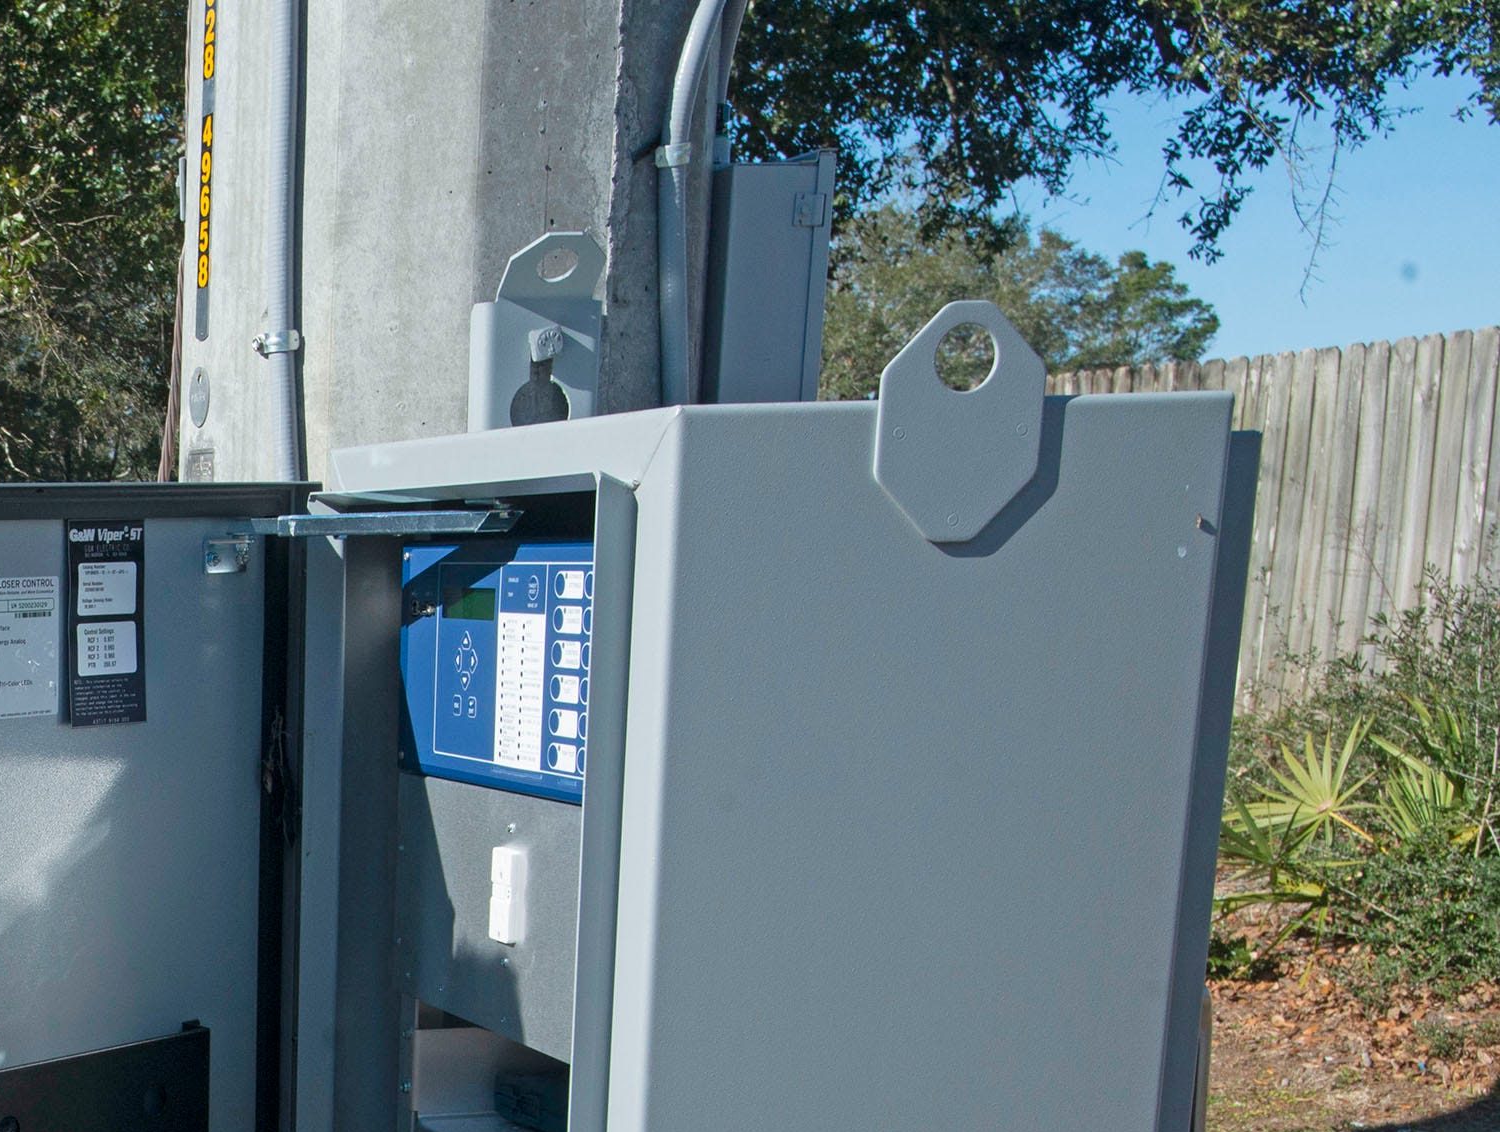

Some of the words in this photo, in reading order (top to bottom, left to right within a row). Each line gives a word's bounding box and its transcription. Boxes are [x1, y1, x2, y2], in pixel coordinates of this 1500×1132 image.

[204, 0, 216, 79] 28
[197, 115, 213, 288] 49658
[69, 528, 96, 542] G&W
[22, 578, 55, 588] CONTROL
